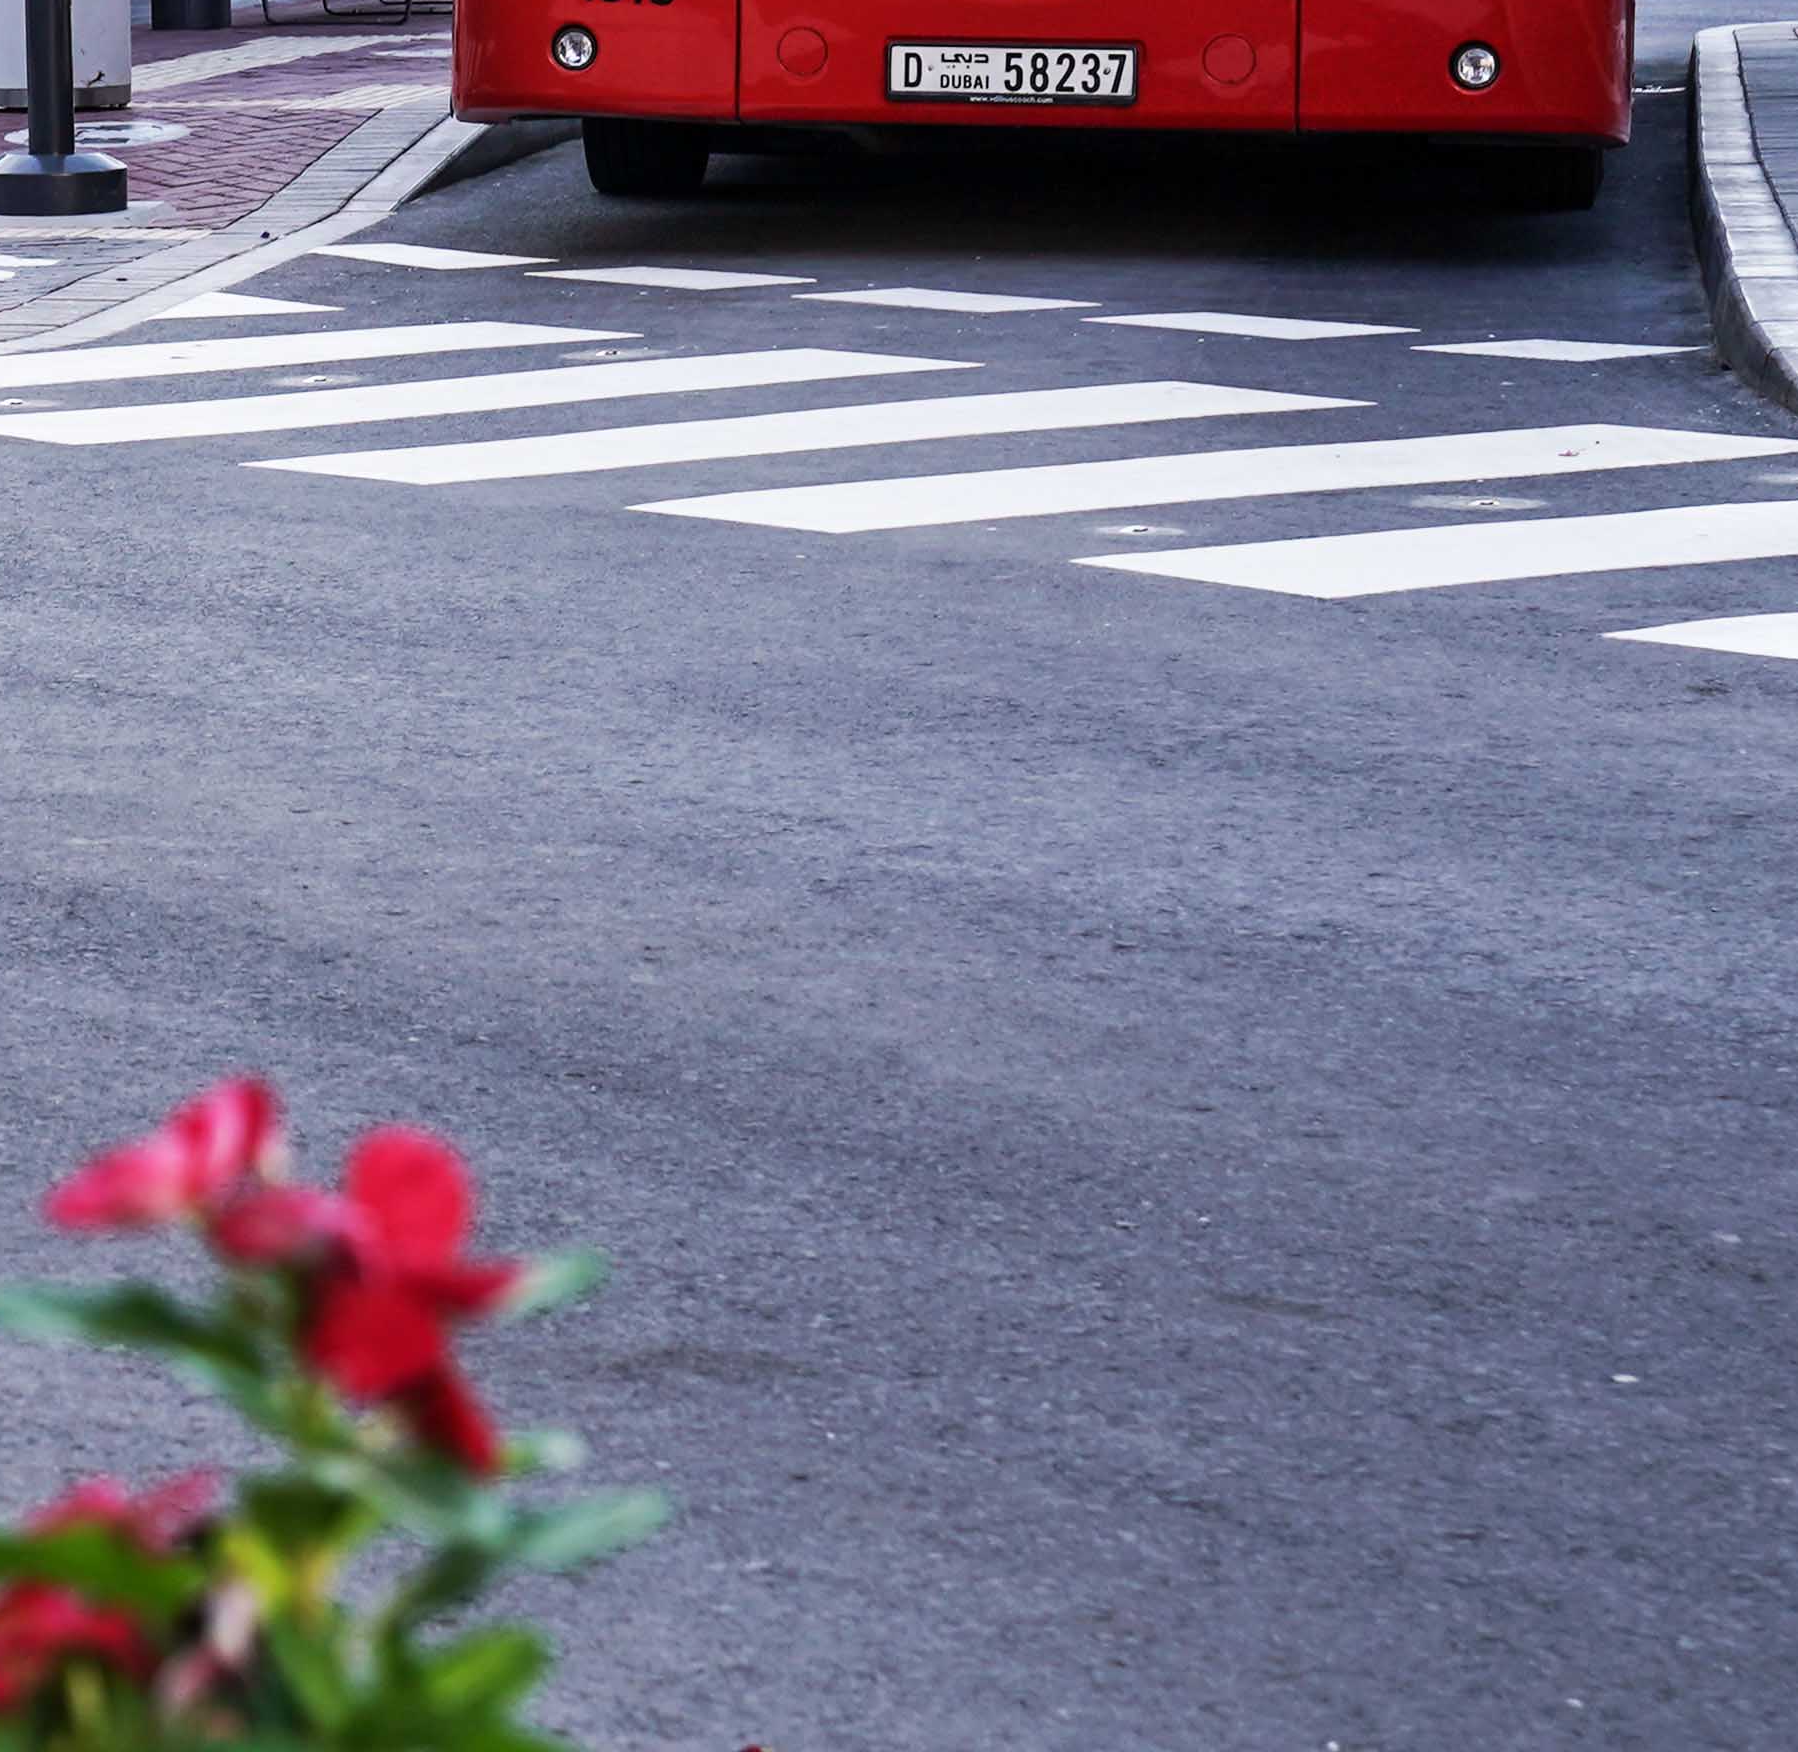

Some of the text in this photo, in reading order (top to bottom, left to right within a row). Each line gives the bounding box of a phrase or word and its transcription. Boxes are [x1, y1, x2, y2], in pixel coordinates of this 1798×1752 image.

[903, 52, 1128, 94] D 58237
[940, 73, 990, 90] DUBAI
